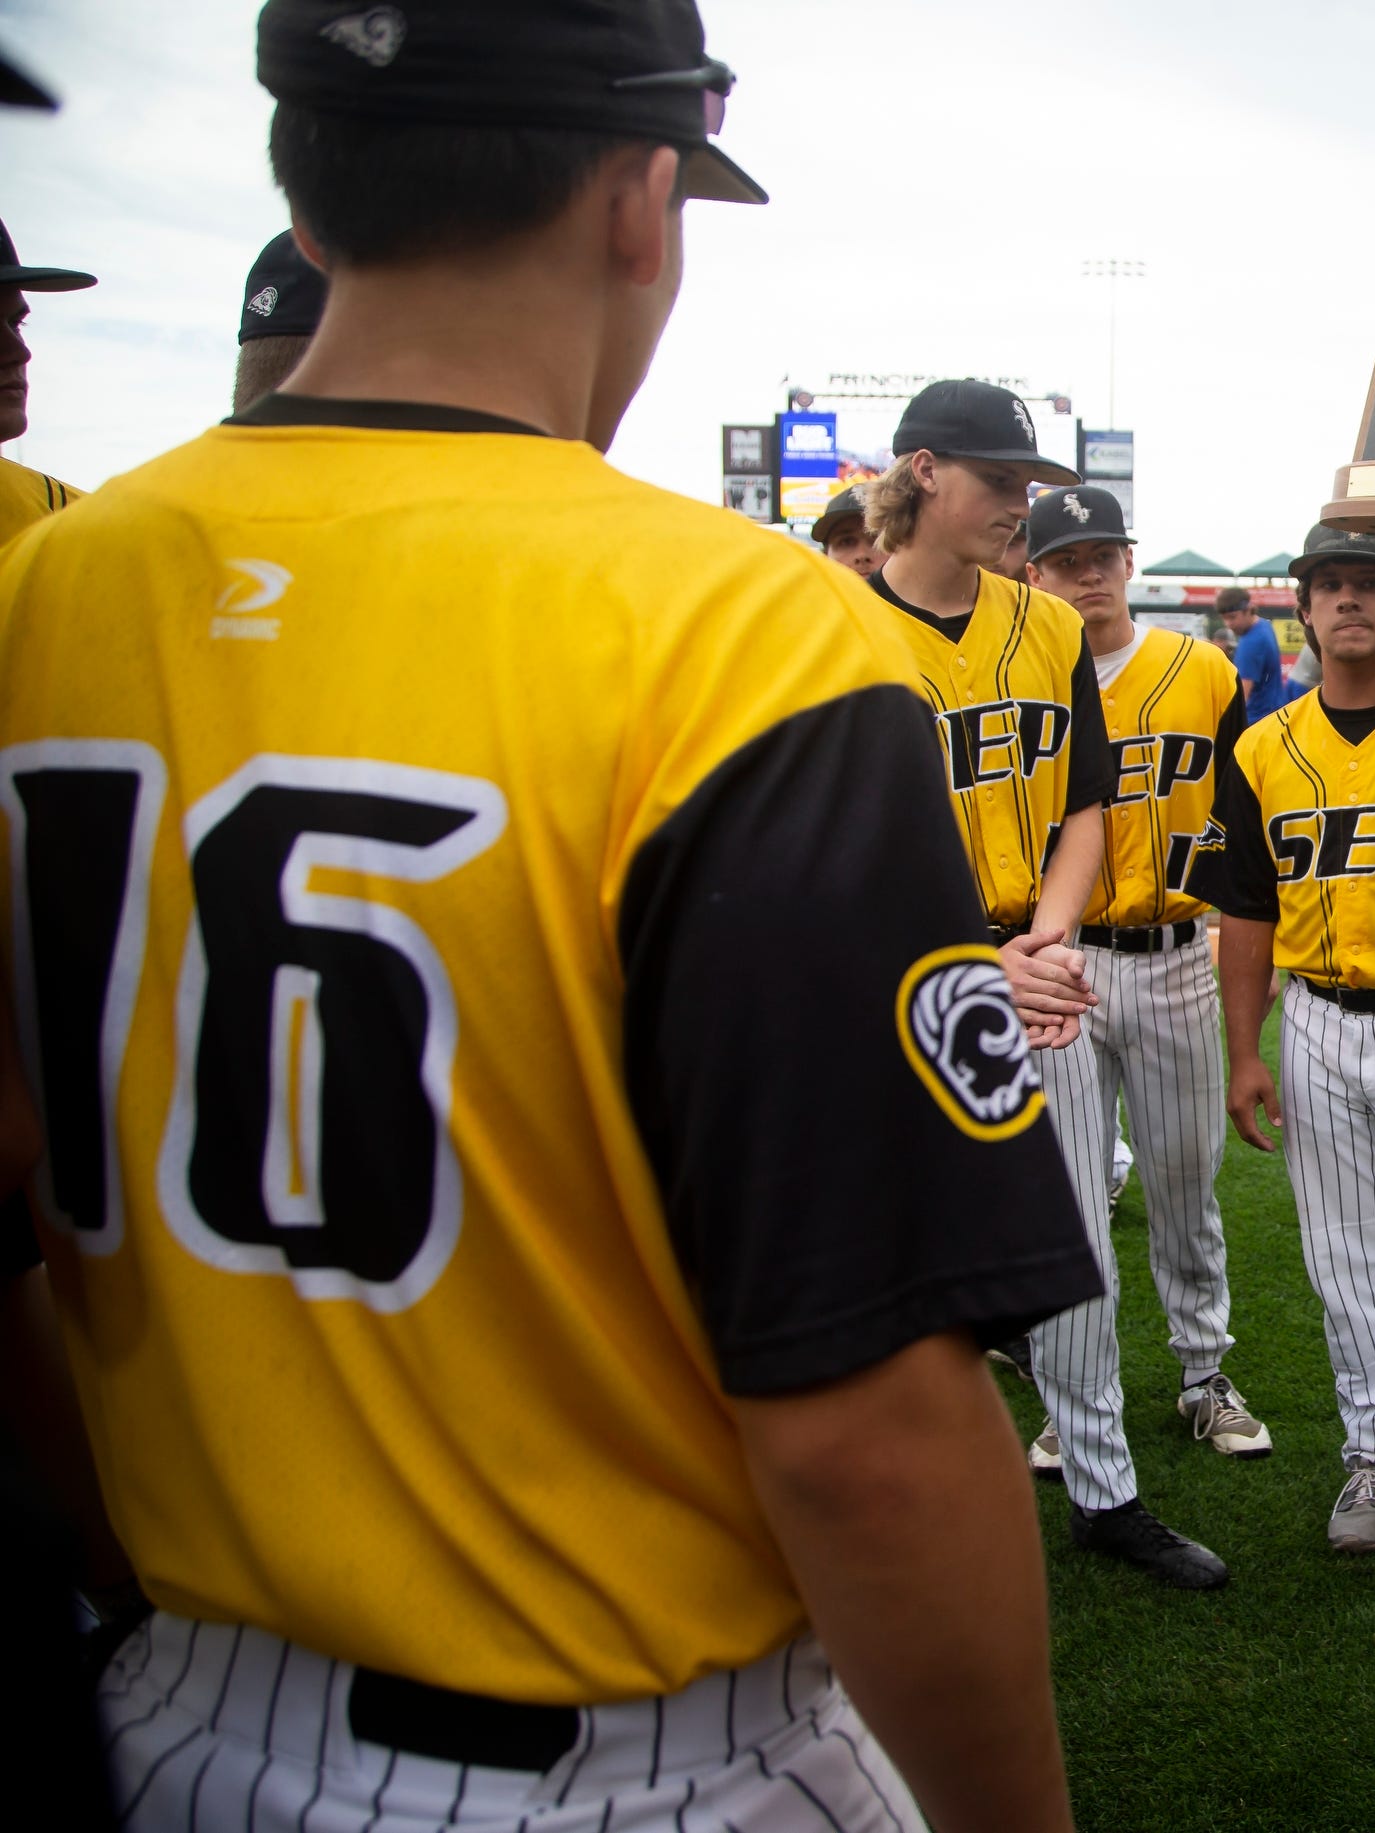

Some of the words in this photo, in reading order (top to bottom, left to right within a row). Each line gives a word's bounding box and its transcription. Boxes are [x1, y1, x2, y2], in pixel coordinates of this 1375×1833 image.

[935, 698, 1072, 793] EP
[1102, 731, 1214, 811] EP
[0, 738, 508, 1314] 16
